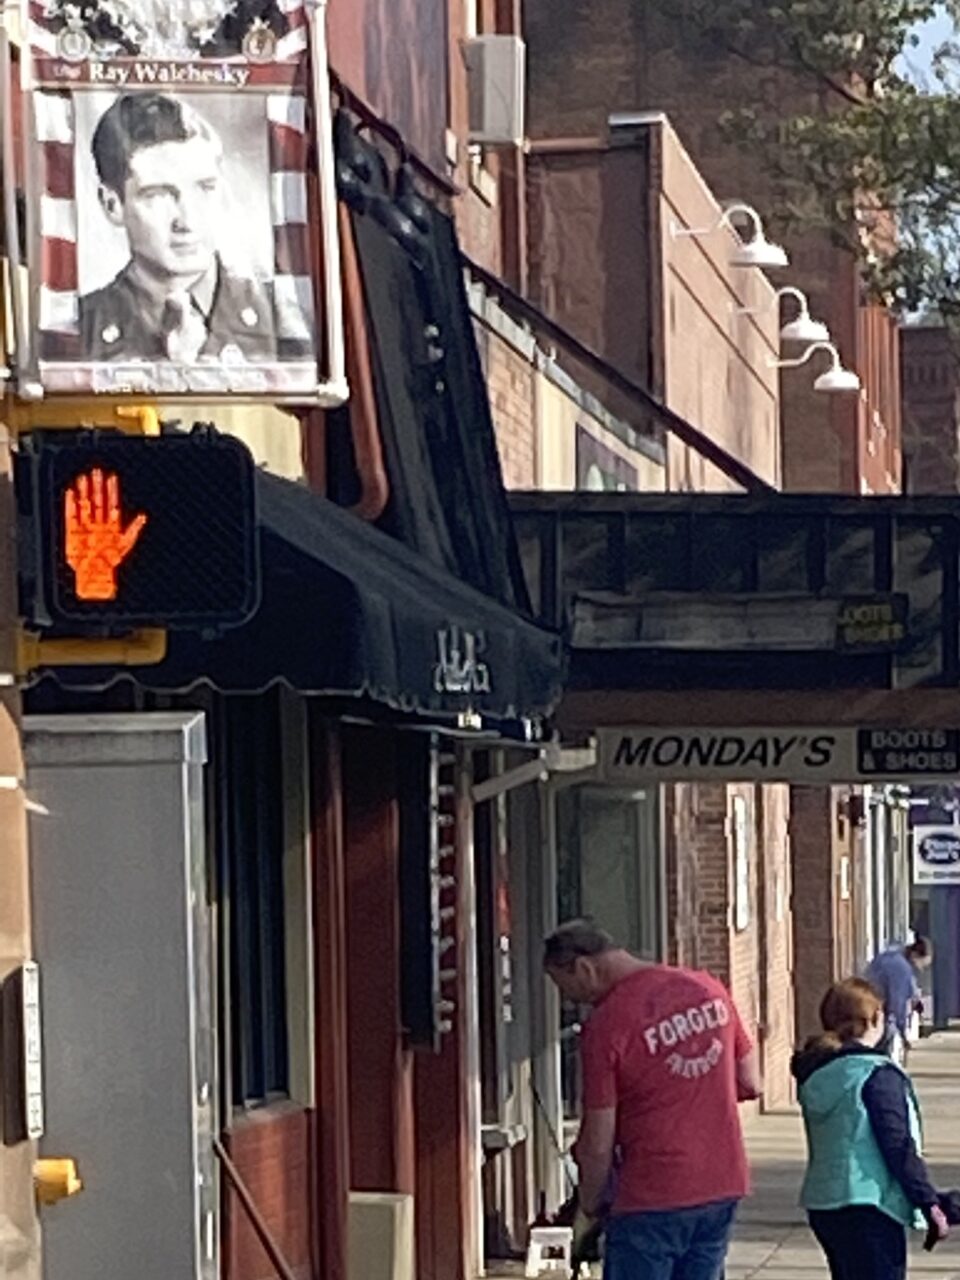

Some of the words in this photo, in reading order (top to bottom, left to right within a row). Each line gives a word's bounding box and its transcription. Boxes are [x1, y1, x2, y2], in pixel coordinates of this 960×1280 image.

[90, 62, 129, 85] Ray
[871, 731, 947, 749] BOOTS
[612, 736, 836, 768] MONDAY'S
[862, 751, 877, 770] &
[885, 751, 957, 770] SHOES
[643, 997, 730, 1056] FORGED
